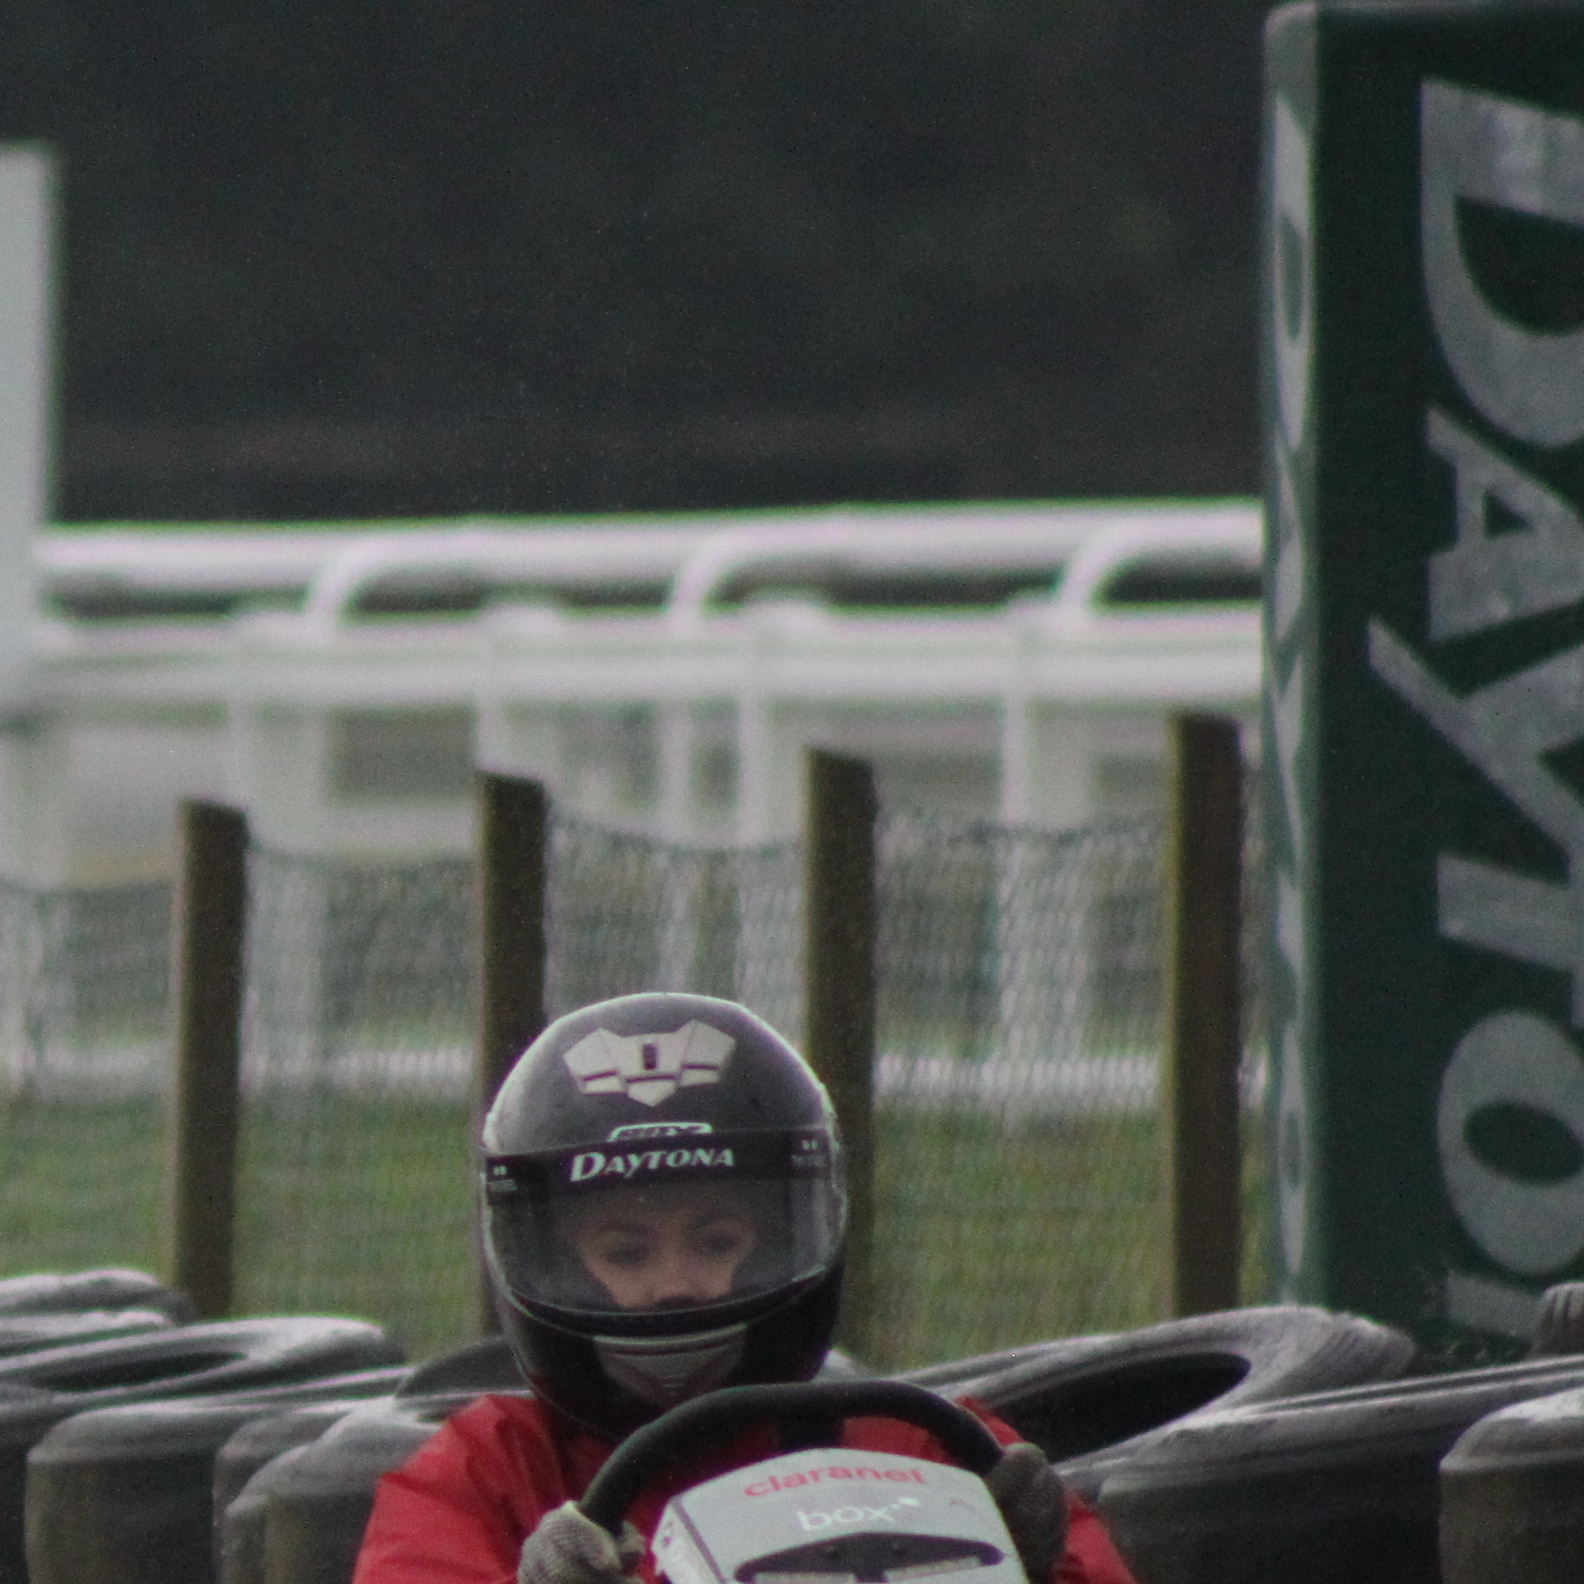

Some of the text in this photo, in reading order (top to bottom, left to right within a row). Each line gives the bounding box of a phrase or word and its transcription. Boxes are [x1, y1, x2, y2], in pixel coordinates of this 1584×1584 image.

[1370, 78, 1584, 1340] DAYTO
[570, 1148, 735, 1182] DAYTONA
[744, 1466, 927, 1497] claranet
[796, 1504, 895, 1532] box
